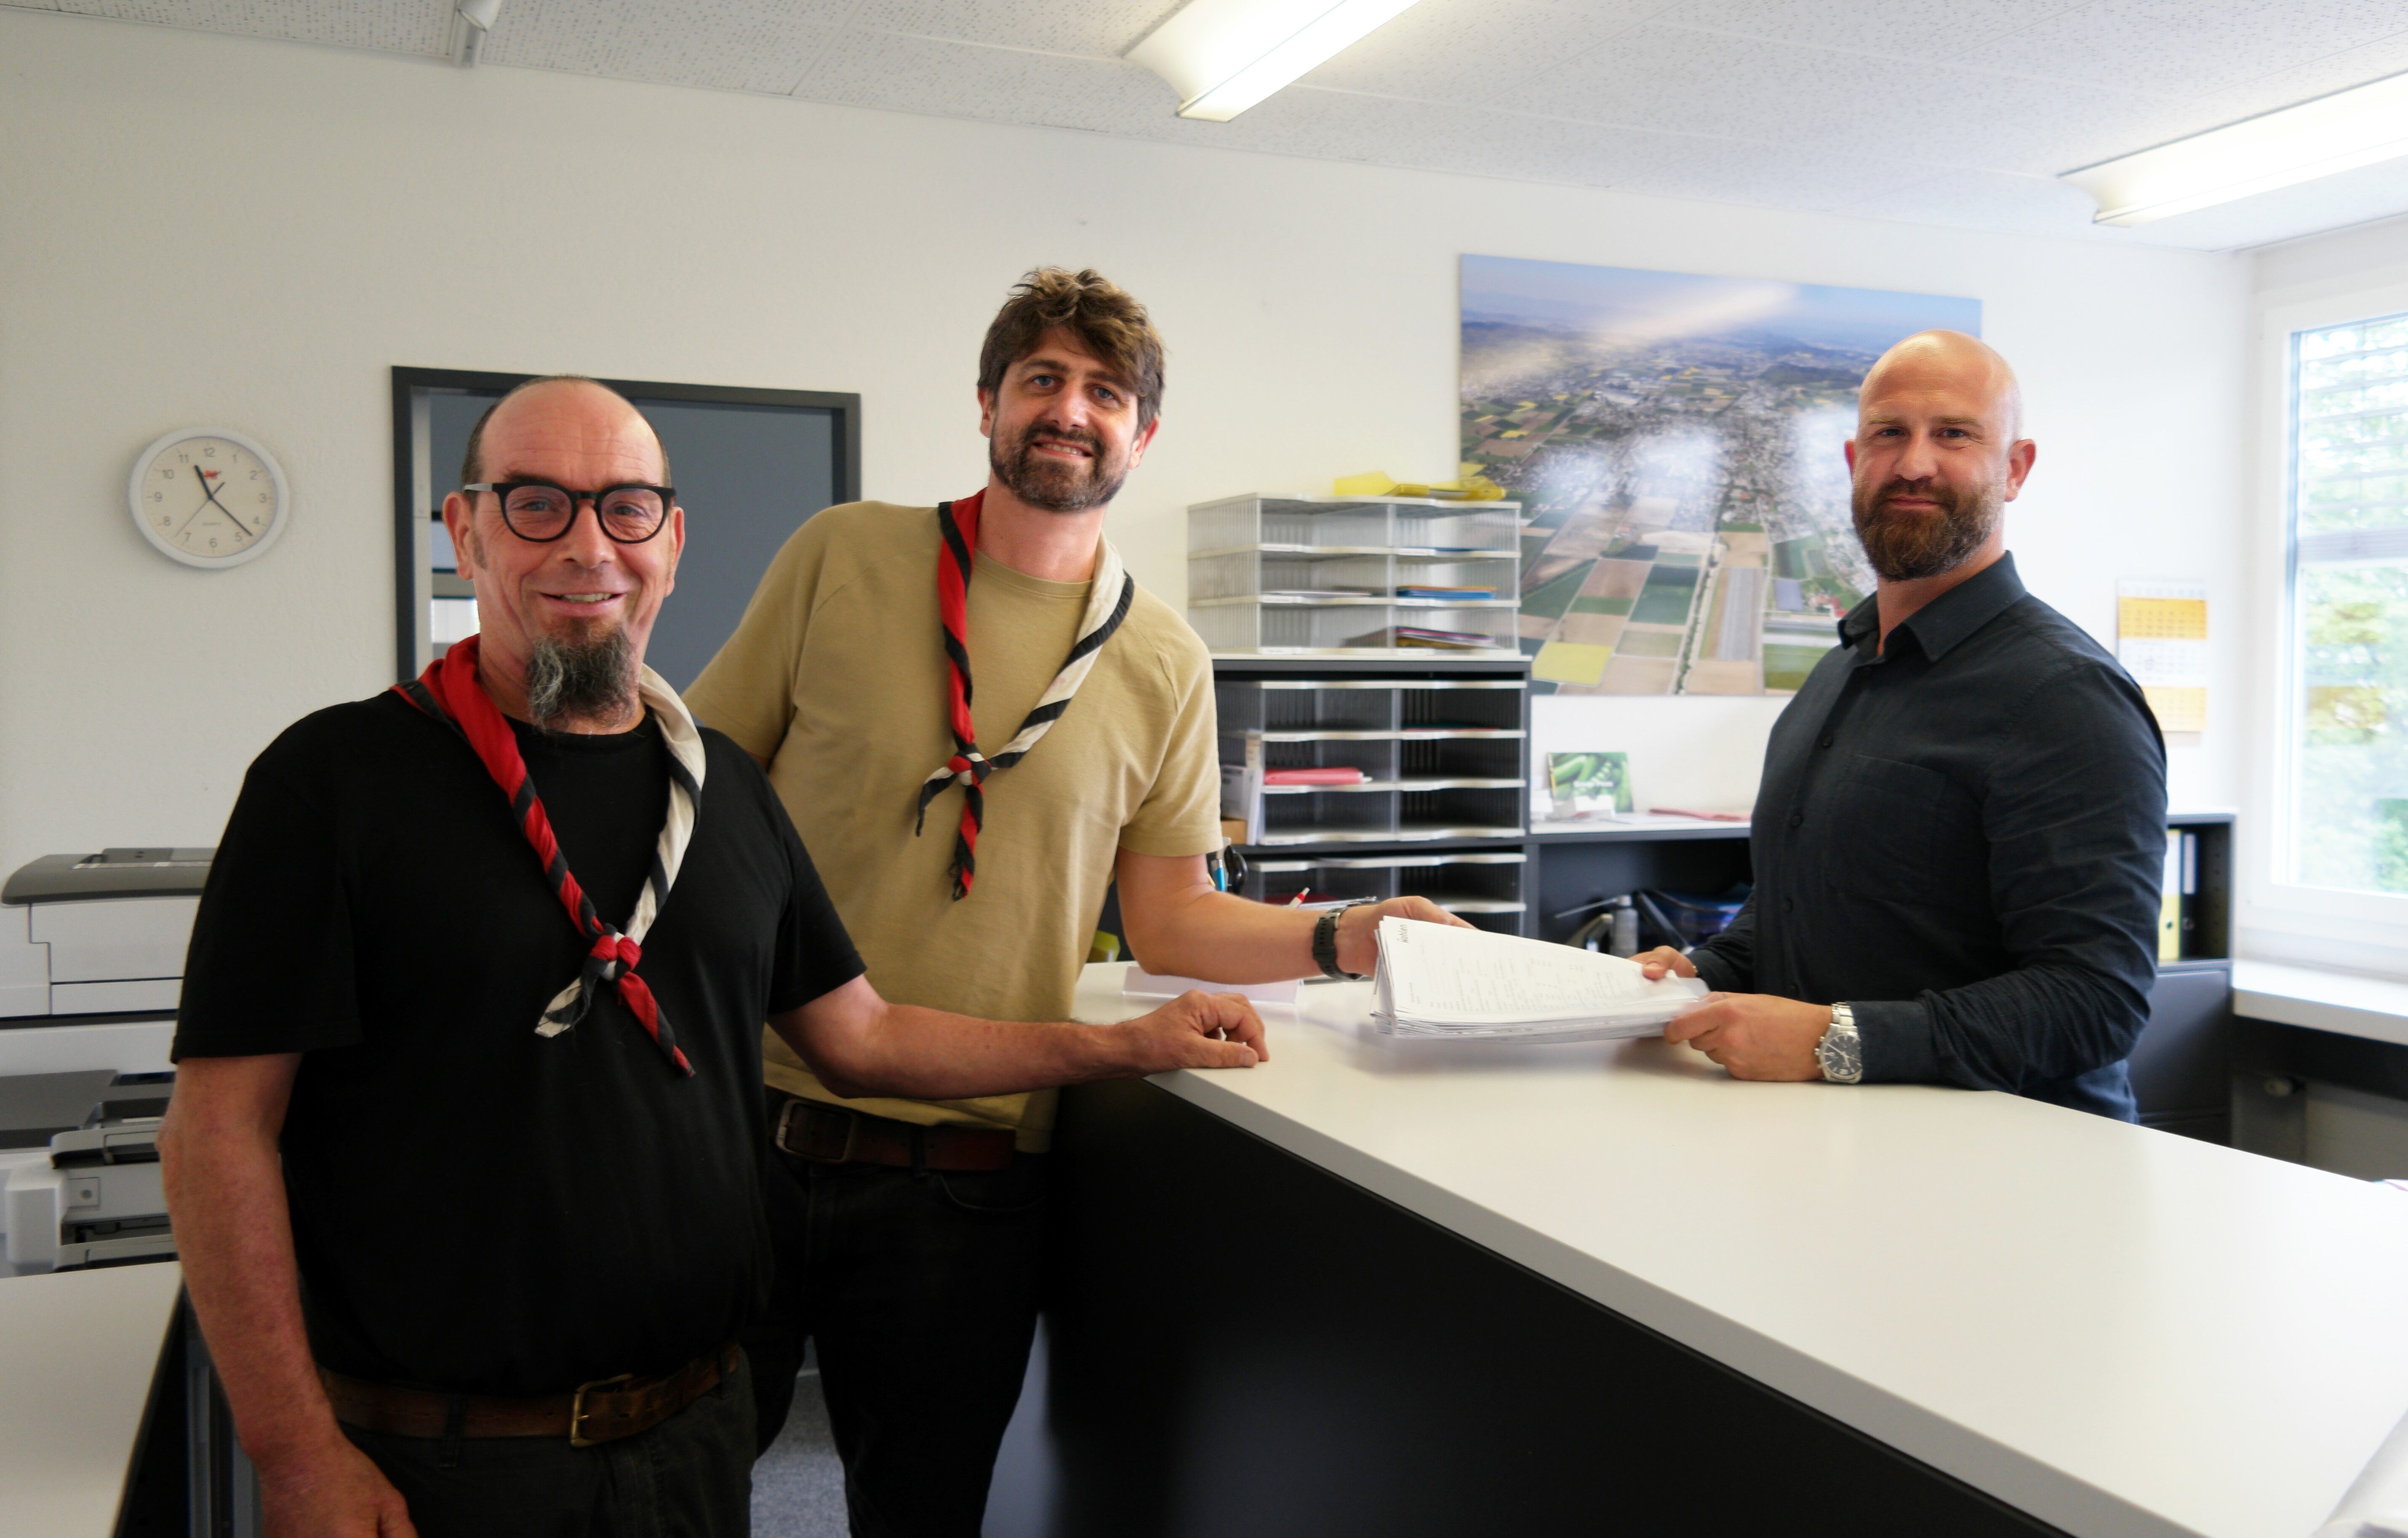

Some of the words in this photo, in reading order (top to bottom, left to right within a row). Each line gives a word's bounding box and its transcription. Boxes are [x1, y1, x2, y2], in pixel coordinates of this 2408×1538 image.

[204, 447, 215, 457] 12
[179, 454, 189, 463] 11
[233, 454, 237, 463] 1
[163, 469, 175, 480] 10
[250, 470, 257, 480] 2
[154, 492, 162, 502] 9
[259, 493, 266, 503] 3
[164, 516, 171, 526] 8
[253, 516, 259, 524] 4
[185, 532, 191, 542] 7
[235, 532, 242, 542] 5
[210, 538, 217, 548] 6
